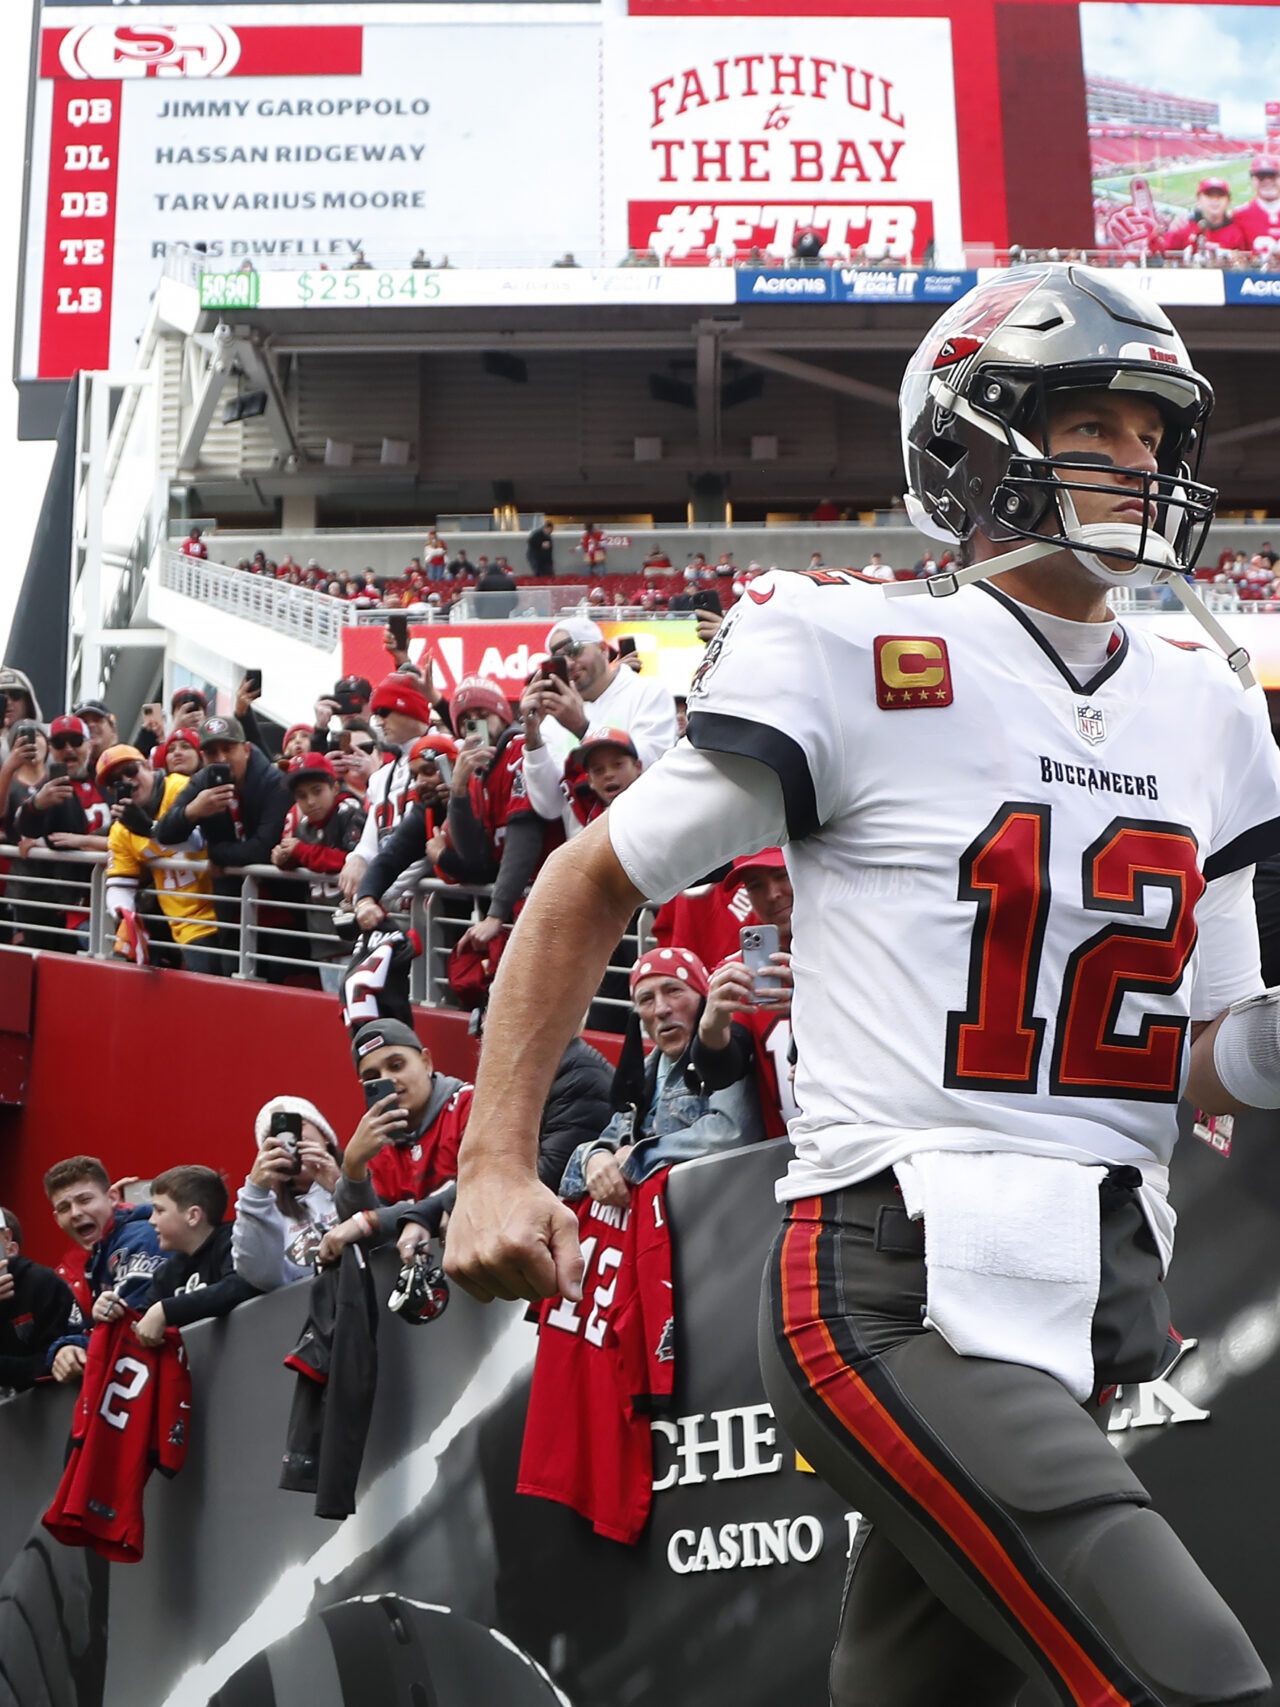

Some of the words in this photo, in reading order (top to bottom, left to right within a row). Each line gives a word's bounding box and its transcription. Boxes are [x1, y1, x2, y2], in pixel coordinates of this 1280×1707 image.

[650, 53, 905, 129] FAITHFUL
[67, 98, 112, 127] QB
[156, 99, 250, 118] JIMMY
[257, 98, 431, 117] GAROPPOLO
[762, 102, 792, 131] to
[64, 145, 110, 171] DL
[155, 146, 269, 164] HASSAN
[275, 144, 426, 162] RIDGEWAY
[651, 140, 771, 182] THE
[790, 140, 905, 182] BAY
[61, 192, 108, 218] DB
[154, 192, 315, 211] TARVARIUS
[322, 190, 426, 209] MOORE
[647, 204, 918, 259] #FTTB
[59, 239, 104, 266] TE
[297, 271, 441, 305] $25,845
[753, 276, 826, 294] Acronis
[57, 287, 102, 314] LB
[880, 640, 945, 688] C
[1081, 719, 1104, 738] NFL
[1039, 755, 1159, 801] BUCCANEERS
[943, 800, 1207, 1102] 12
[547, 1236, 624, 1348] 12
[668, 1514, 824, 1575] CASINO
